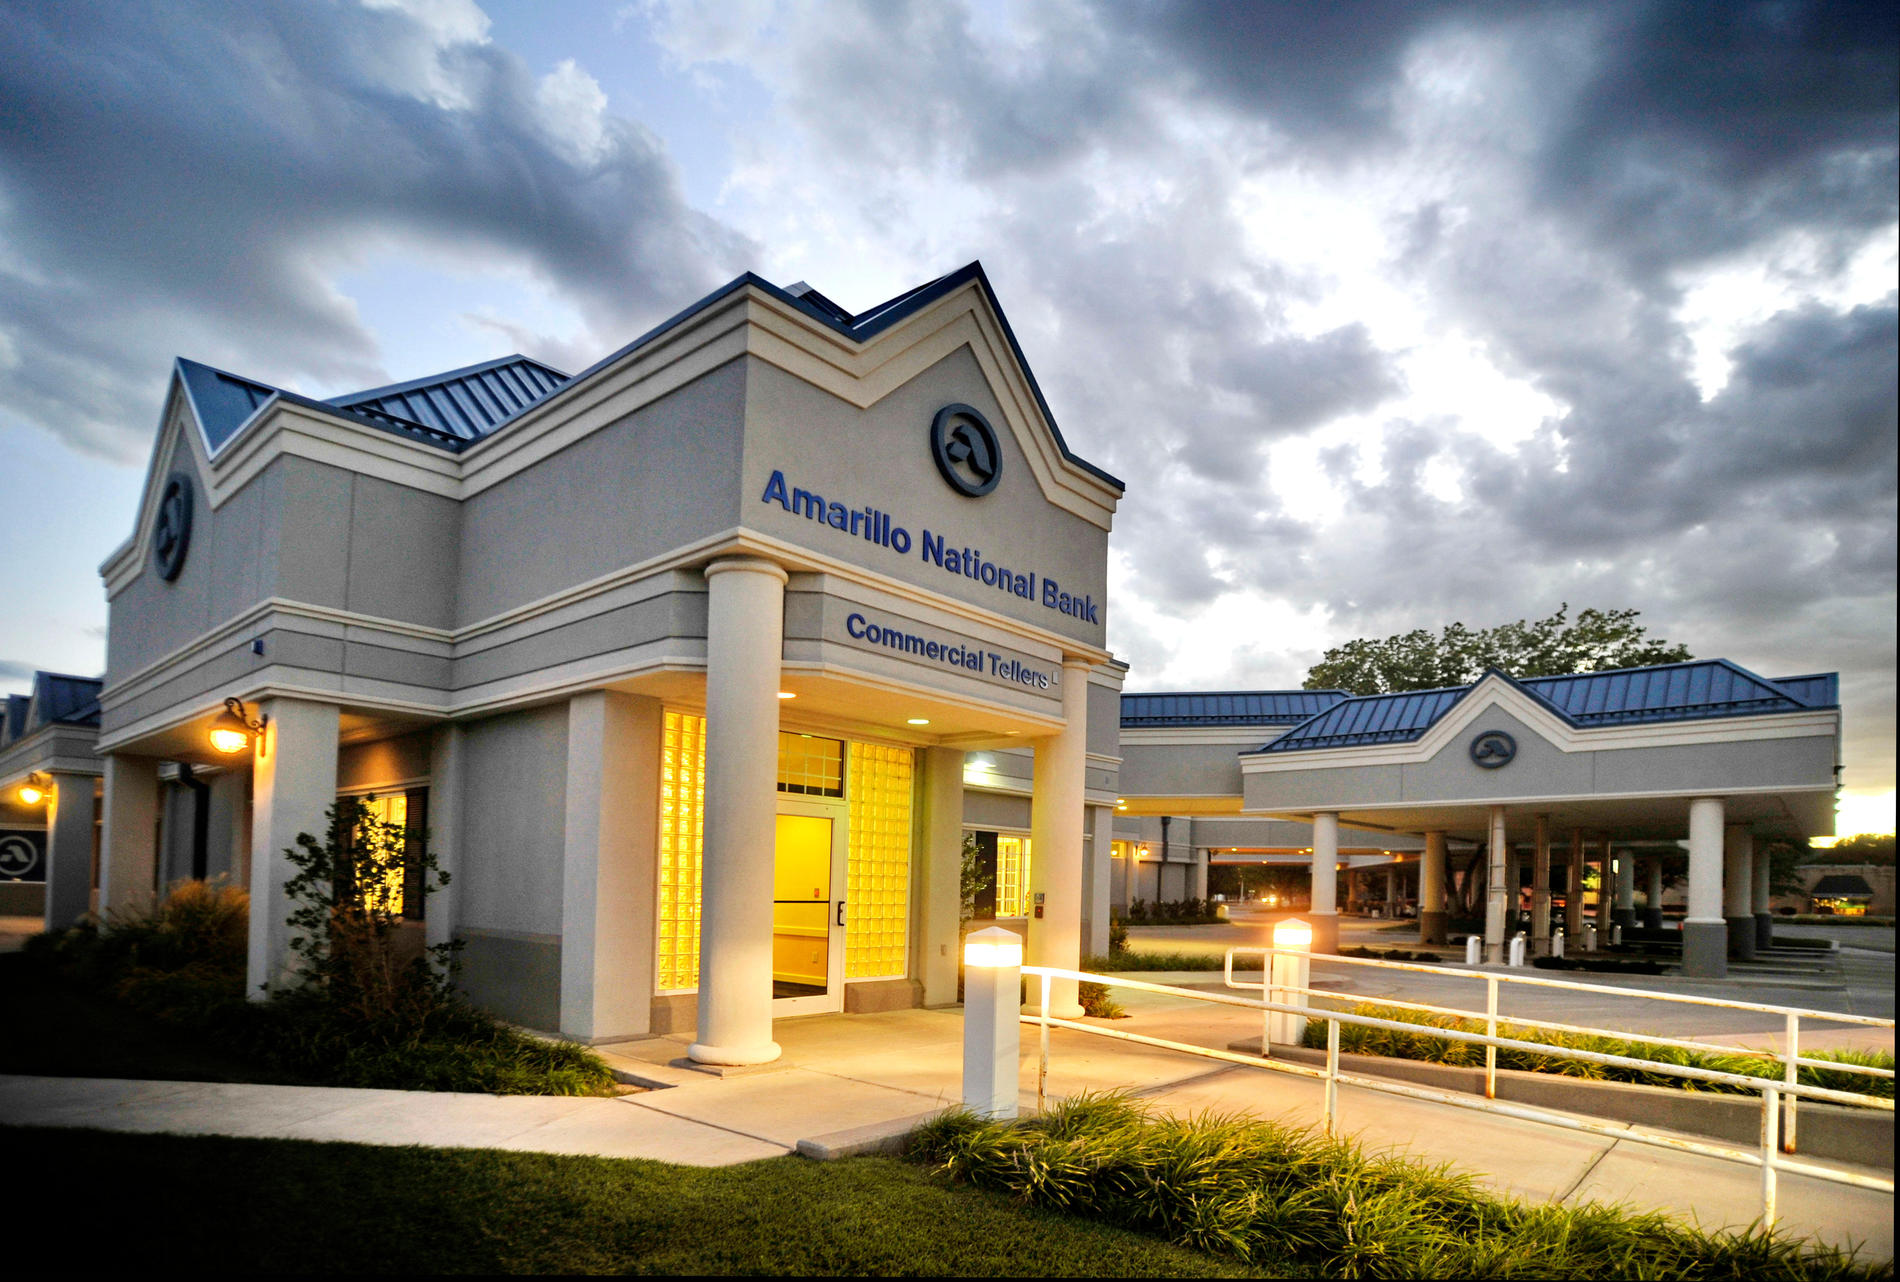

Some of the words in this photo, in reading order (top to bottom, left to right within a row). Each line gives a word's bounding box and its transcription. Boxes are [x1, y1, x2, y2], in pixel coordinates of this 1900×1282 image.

[762, 470, 911, 553] Amarillo
[921, 530, 1035, 601] National
[1042, 579, 1098, 624] Bank
[846, 613, 984, 672] Commercial
[987, 654, 1049, 689] Tellers
